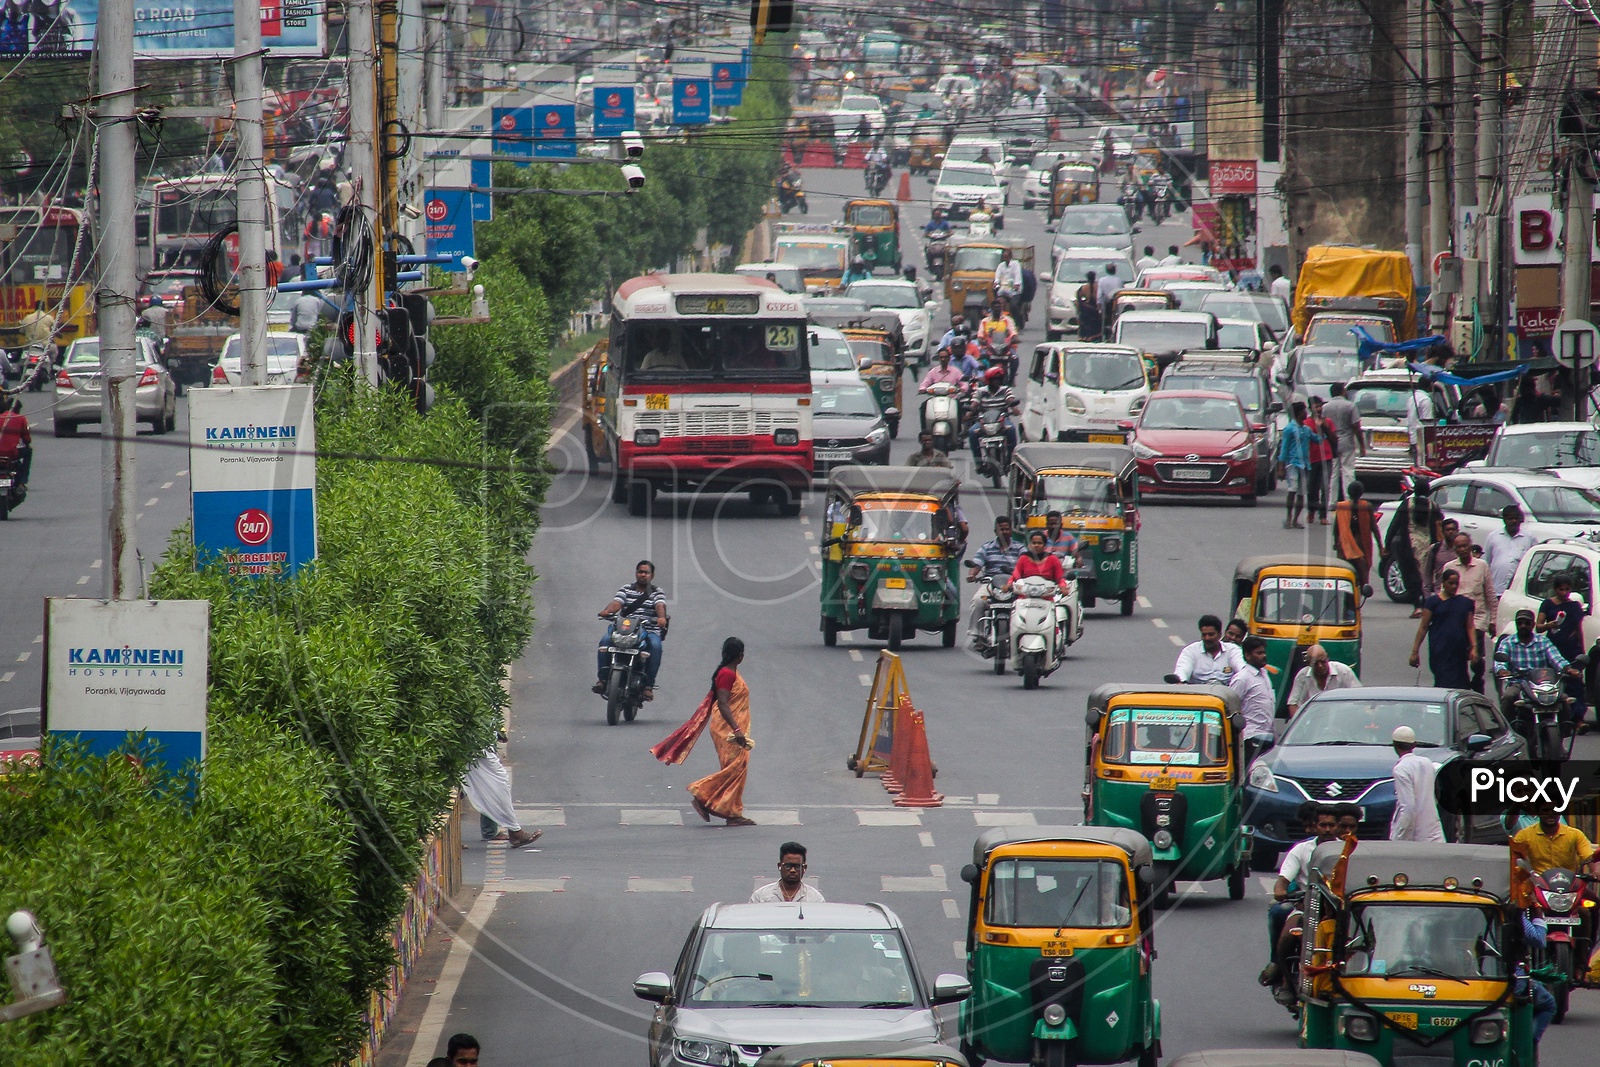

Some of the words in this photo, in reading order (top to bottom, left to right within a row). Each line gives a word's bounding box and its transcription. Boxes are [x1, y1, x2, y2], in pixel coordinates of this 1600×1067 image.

[150, 7, 195, 21] ROAD
[1520, 209, 1554, 250] B
[206, 425, 296, 440] KAMINENI
[206, 442, 296, 450] HOSPITALS
[247, 456, 284, 464] Vijayawada
[242, 522, 265, 534] 24/7
[1100, 559, 1121, 571] CNG
[1283, 580, 1333, 589] HOSANNA
[920, 591, 943, 603] CNG
[69, 646, 183, 665] KAMINENI
[69, 668, 183, 677] HOSPITALS
[85, 687, 118, 696] Poranki,
[119, 687, 166, 696] Vijayawada
[1409, 984, 1437, 993] ape
